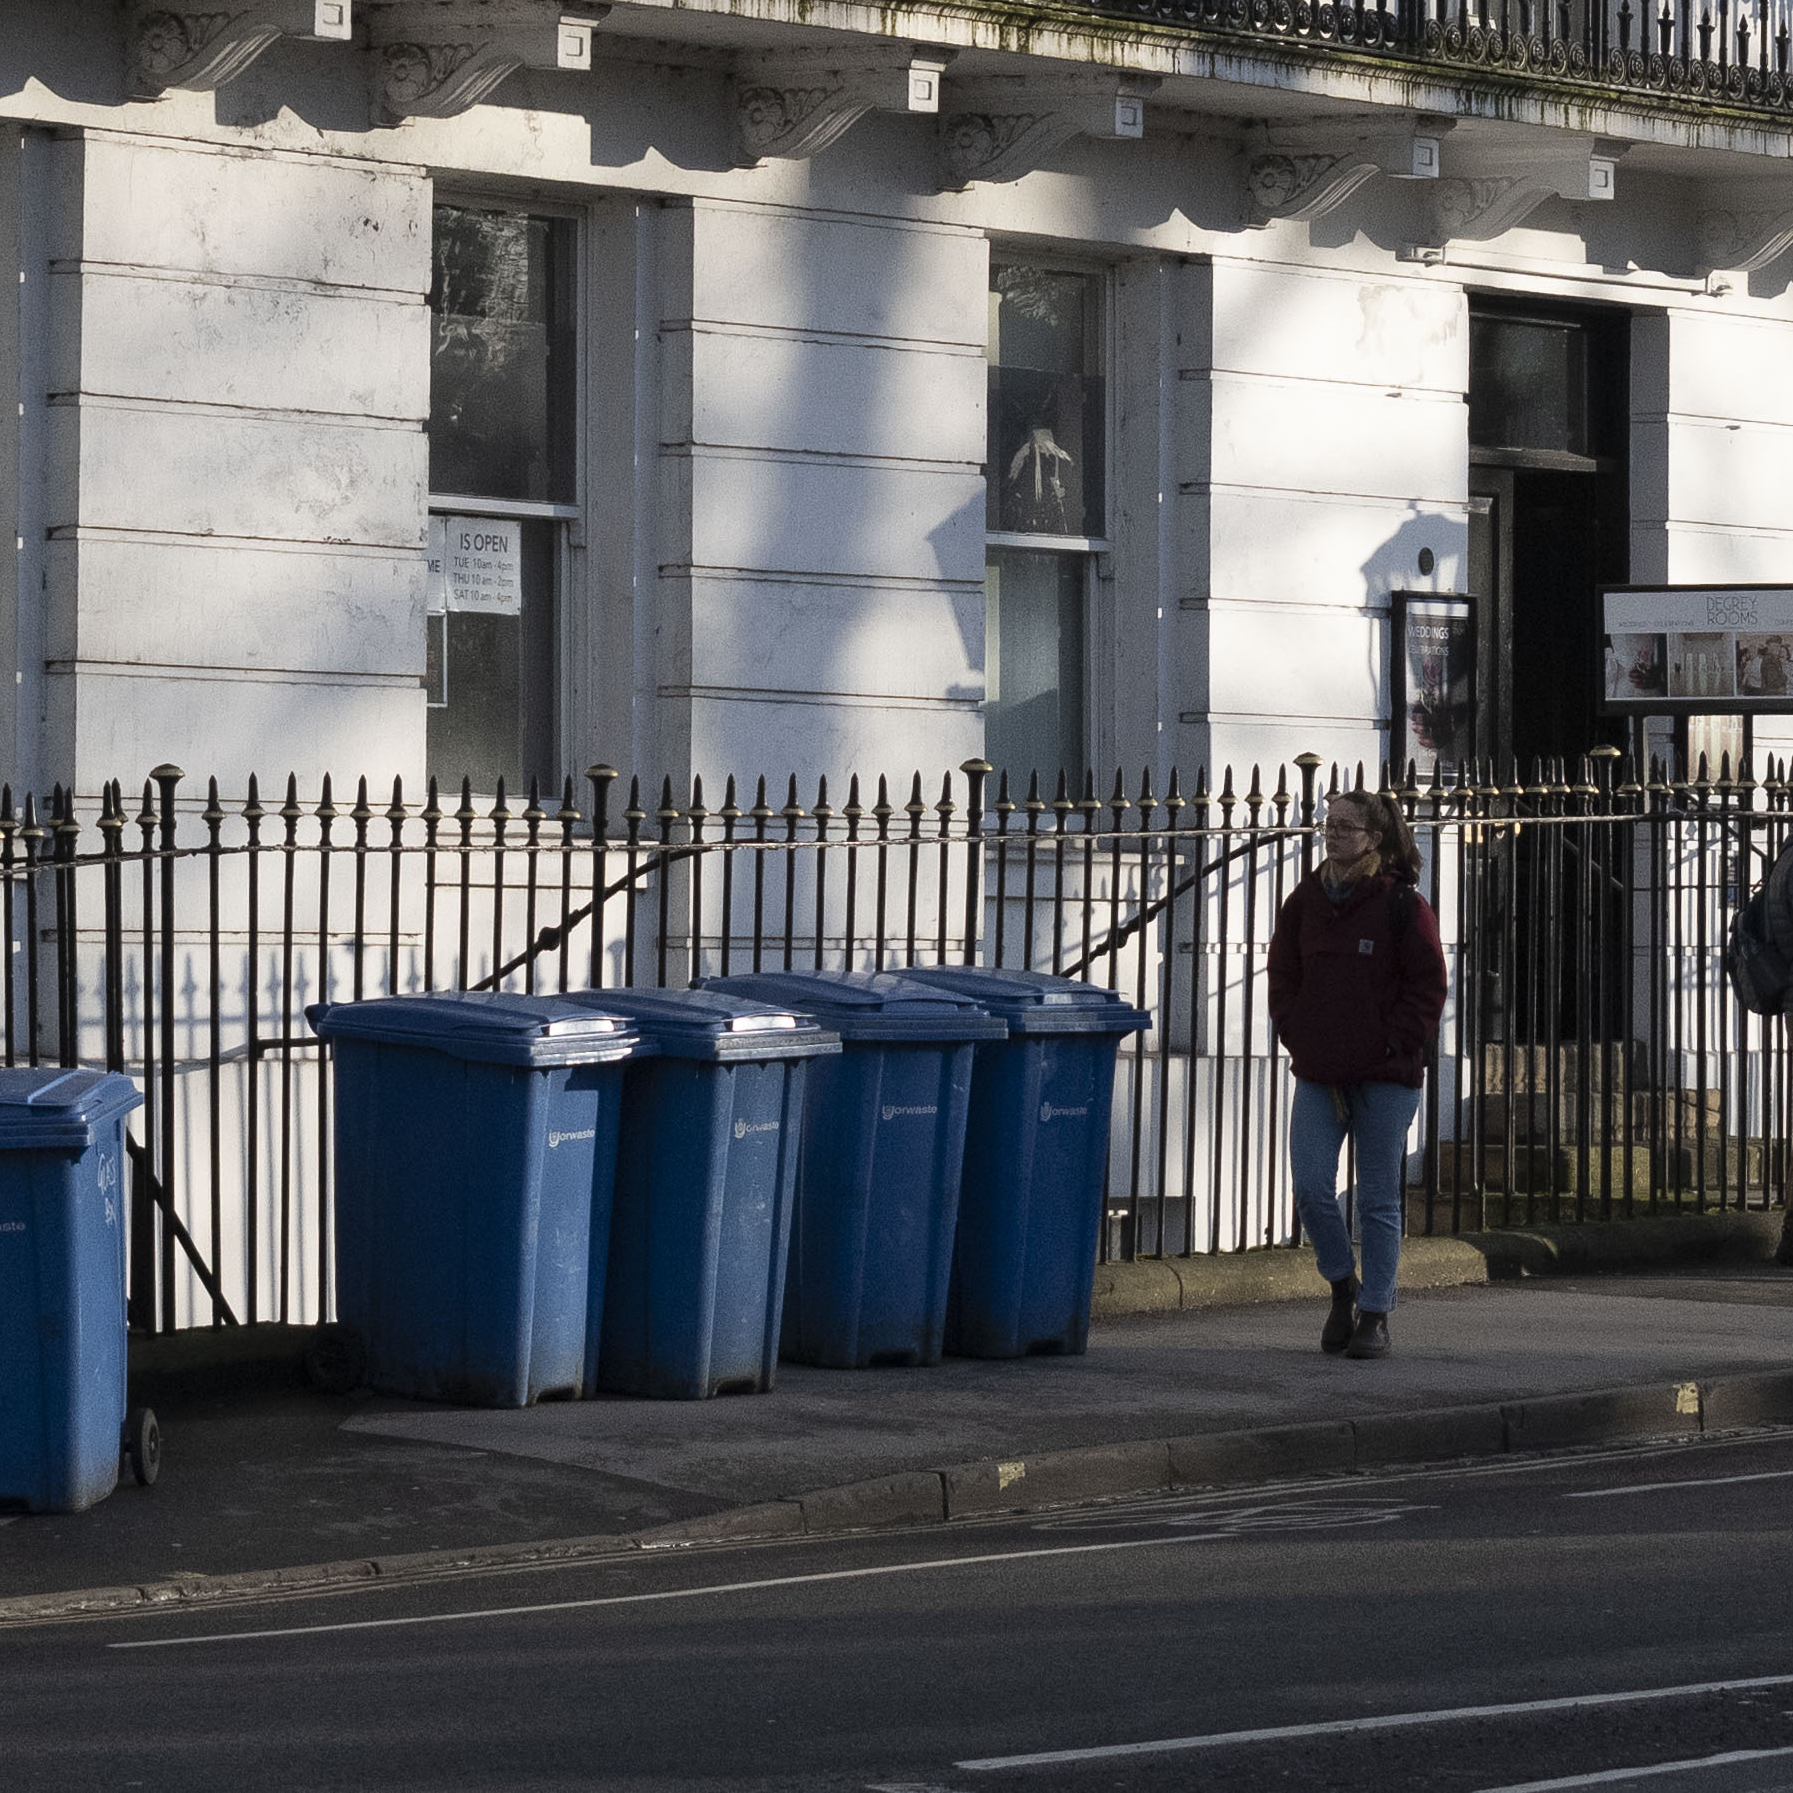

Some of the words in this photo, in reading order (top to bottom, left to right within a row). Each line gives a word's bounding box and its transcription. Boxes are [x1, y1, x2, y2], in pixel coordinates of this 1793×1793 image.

[460, 533, 471, 550] IS
[474, 534, 508, 553] OPEN
[454, 556, 470, 569] TUE
[453, 572, 470, 585] THU
[453, 588, 469, 600] SAT
[1707, 611, 1759, 626] ROOMS
[1407, 624, 1450, 640] WEDDINGS
